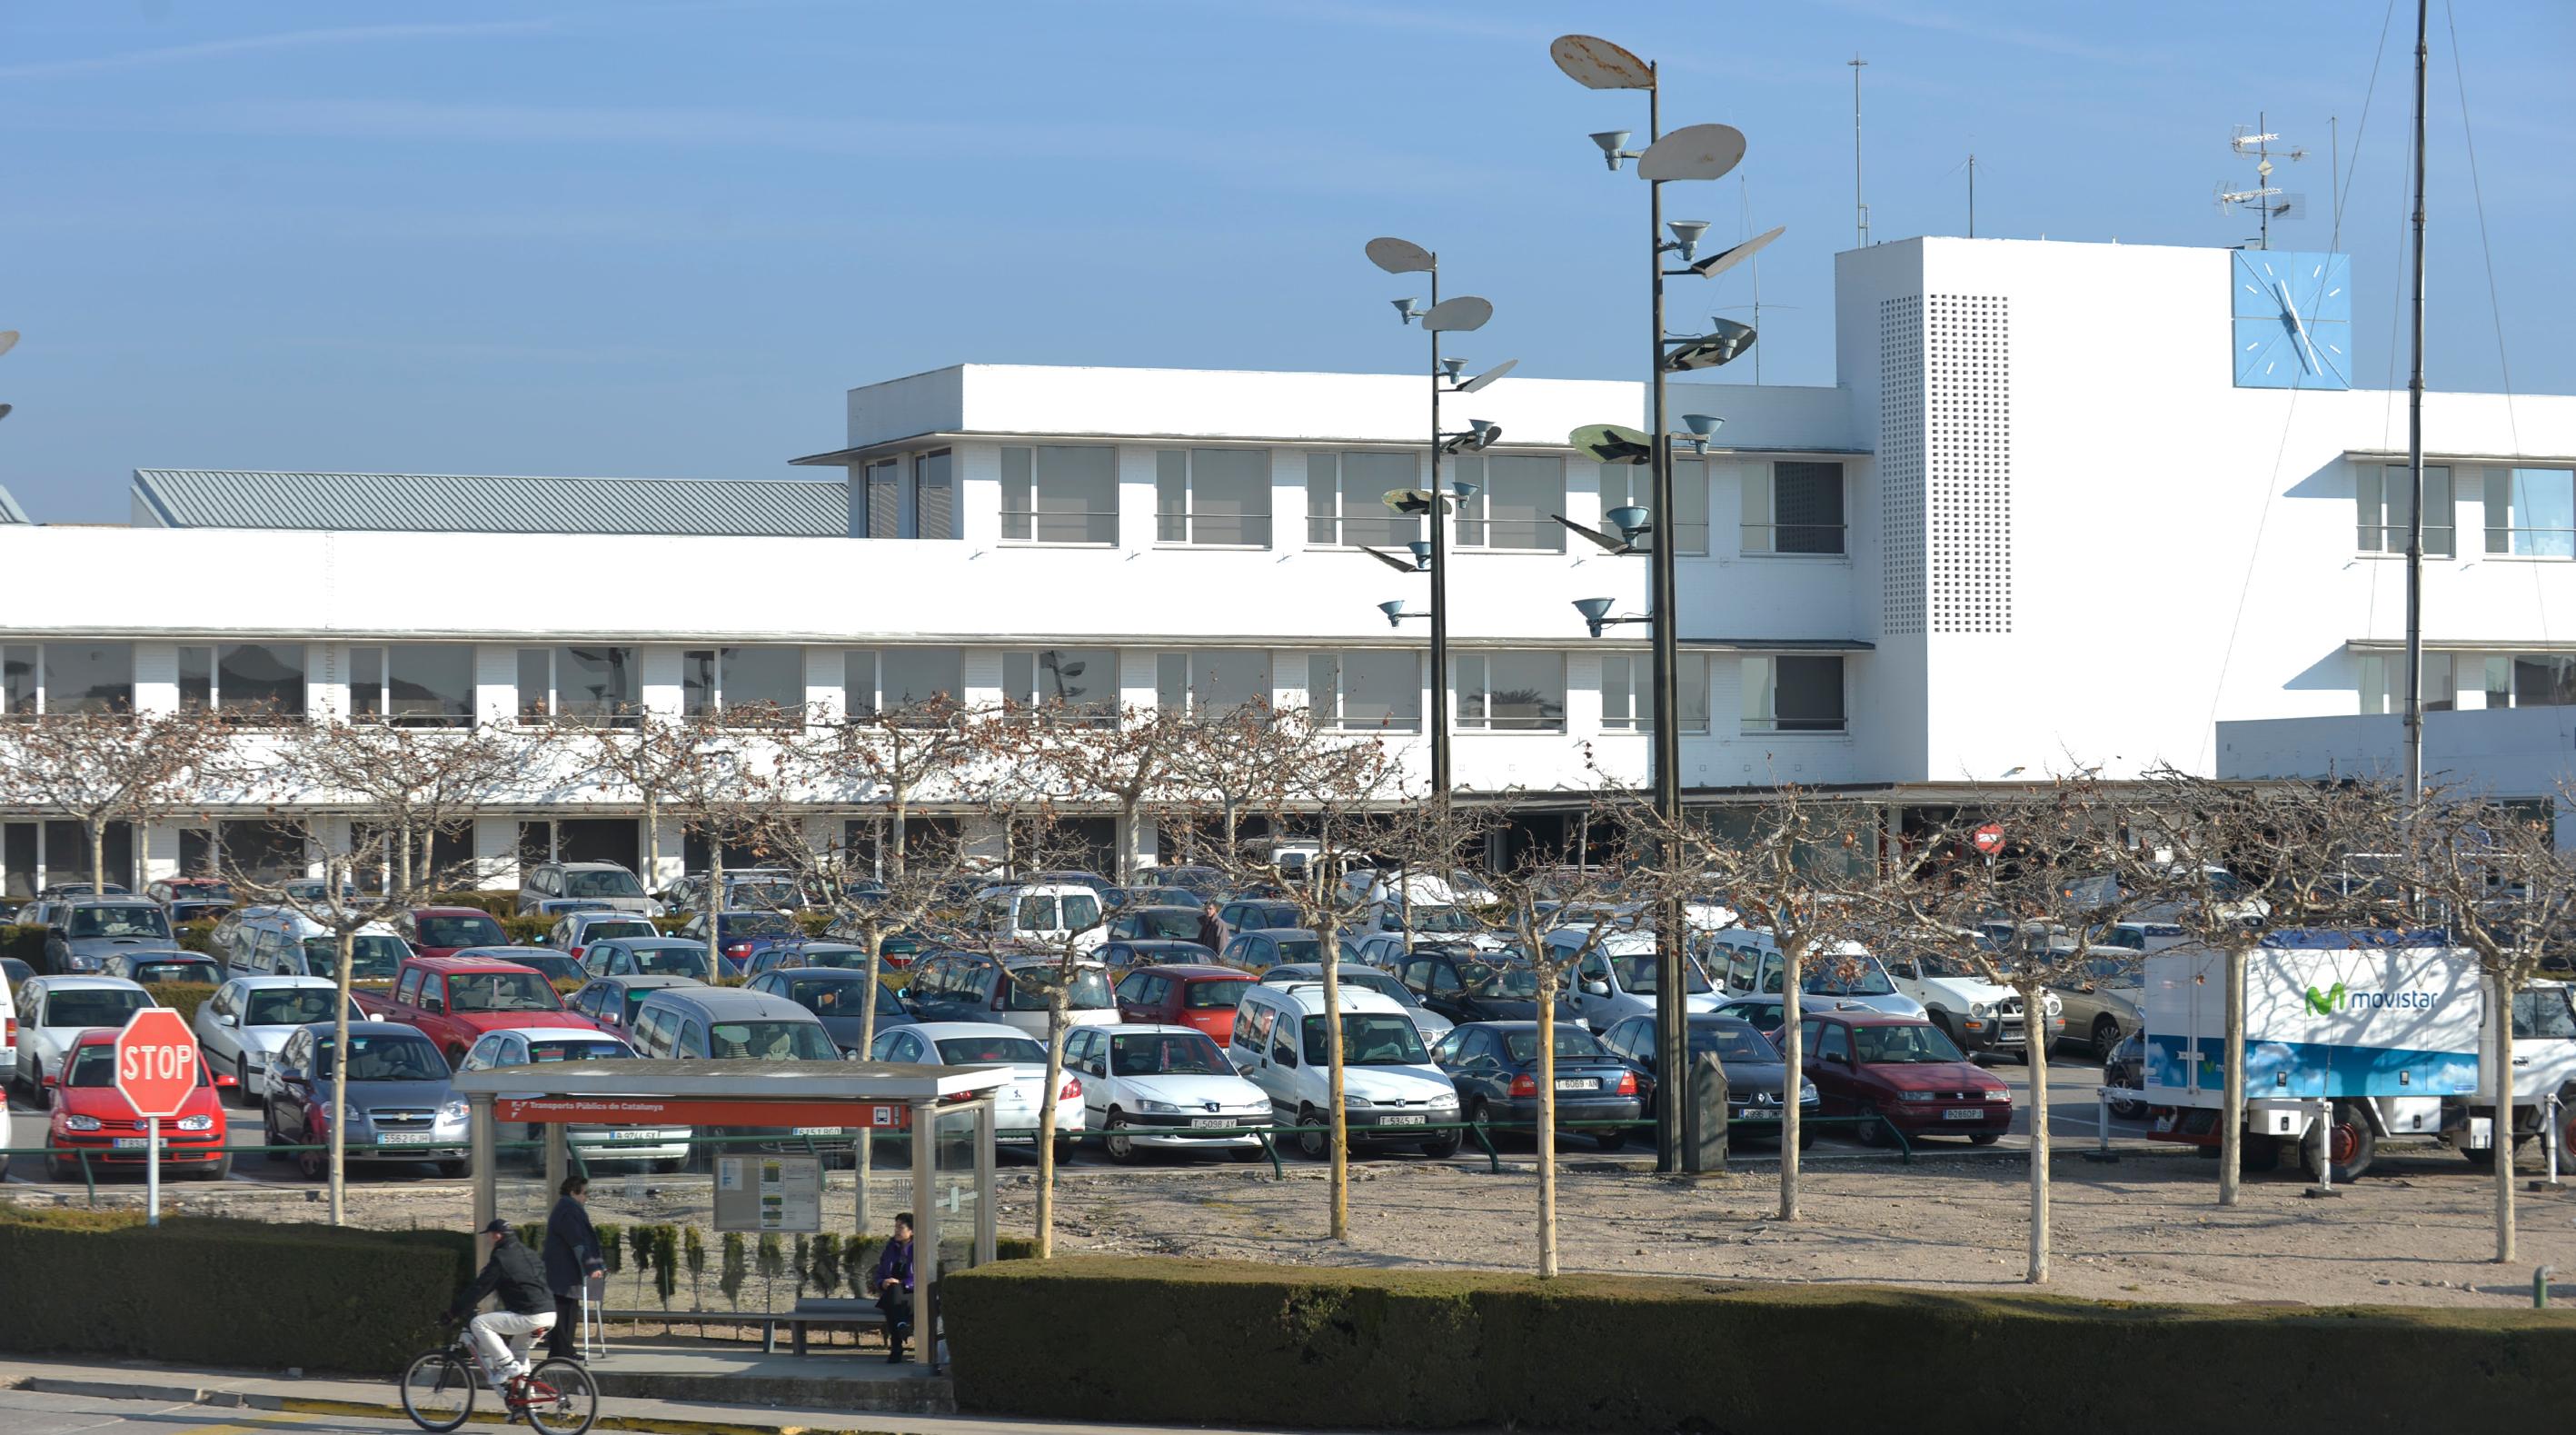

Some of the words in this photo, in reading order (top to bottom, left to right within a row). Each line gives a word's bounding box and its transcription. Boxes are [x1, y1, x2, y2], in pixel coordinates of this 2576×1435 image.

[2352, 990, 2438, 1009] movistar
[122, 1045, 193, 1081] STOP
[609, 1102, 620, 1111] de
[622, 1102, 664, 1112] Catalunya
